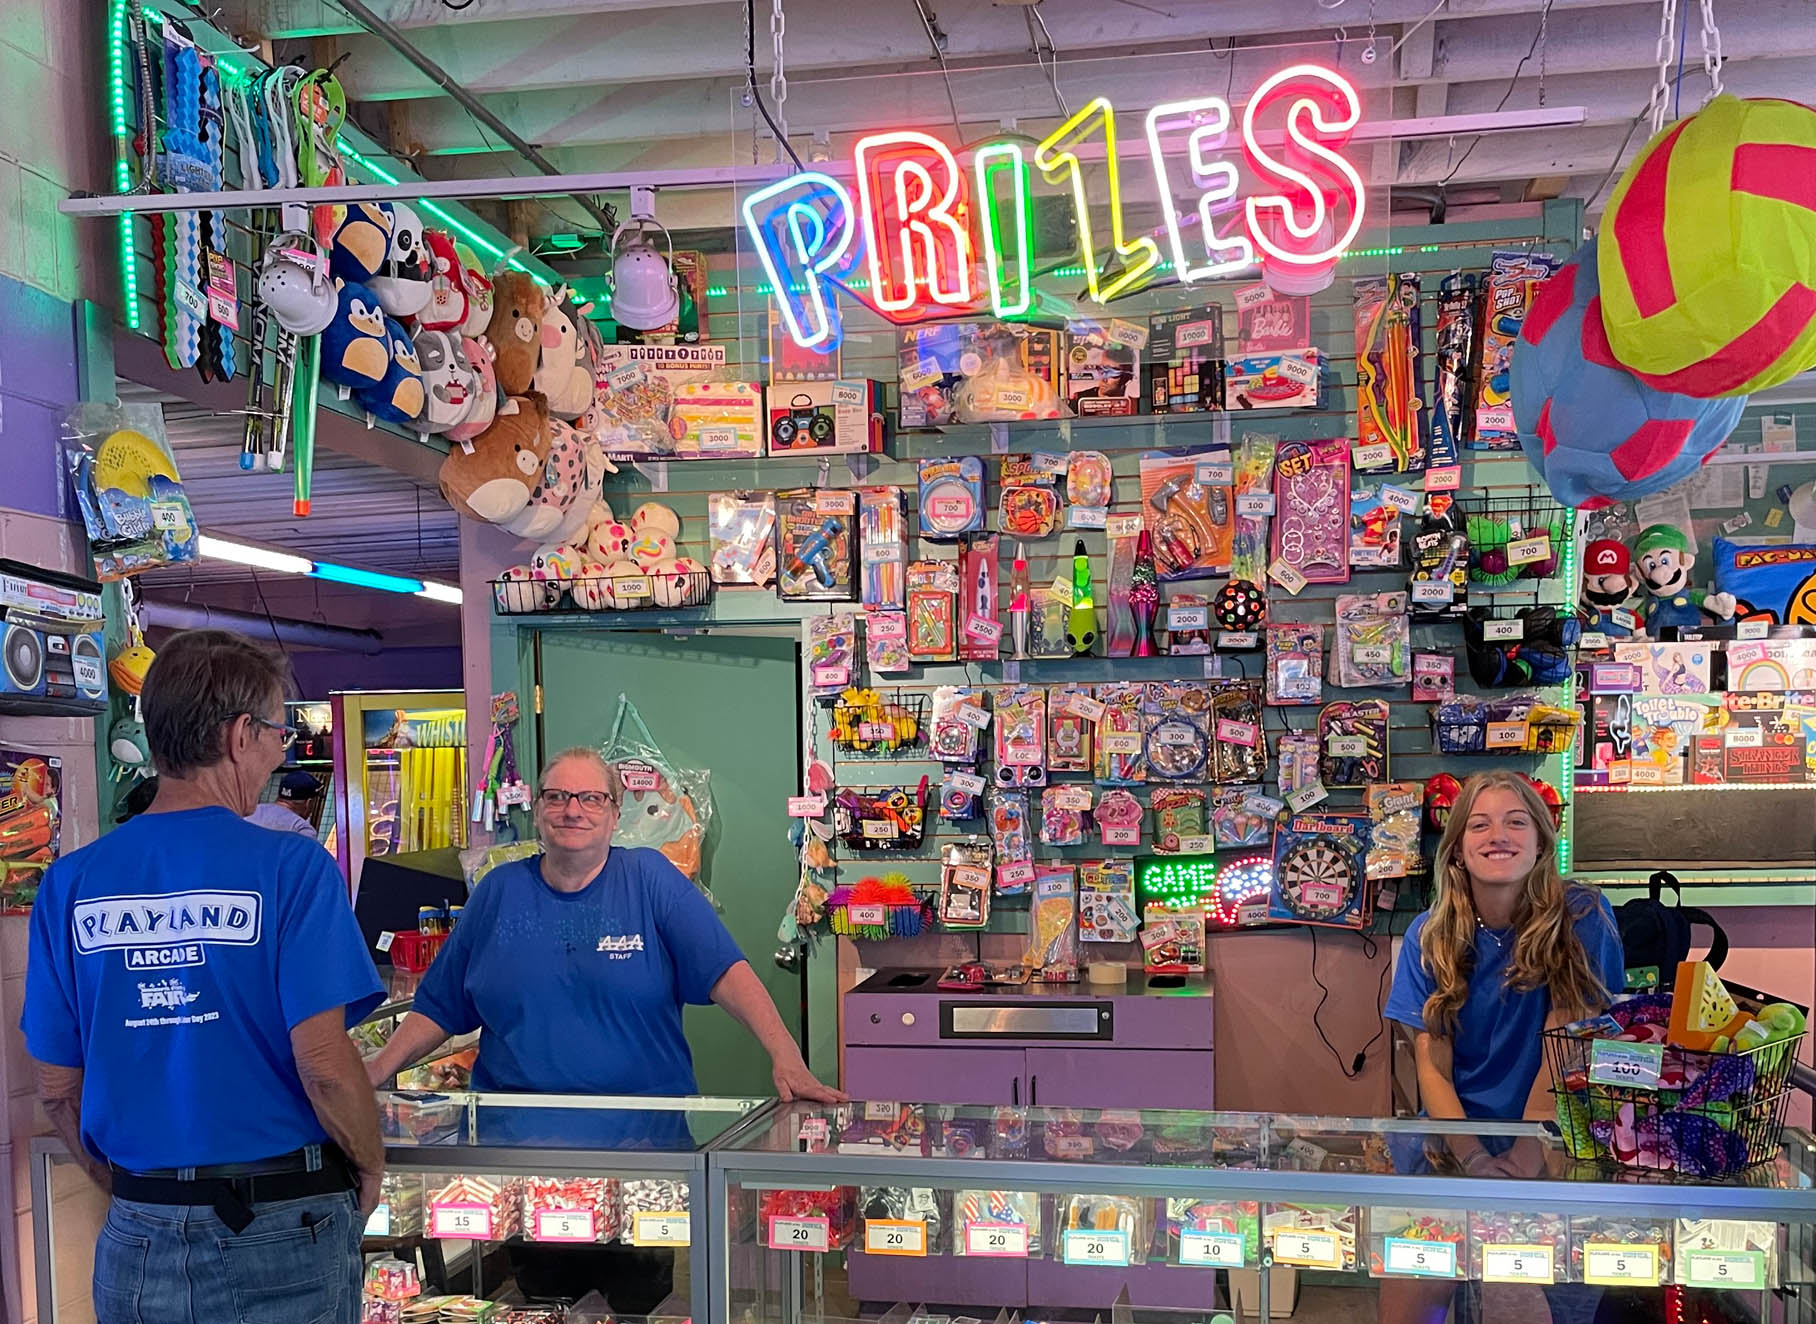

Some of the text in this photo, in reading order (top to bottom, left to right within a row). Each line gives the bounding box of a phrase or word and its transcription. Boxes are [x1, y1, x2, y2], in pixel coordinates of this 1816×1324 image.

[1243, 291, 1265, 304] 5000
[1494, 287, 1514, 300] POP
[185, 291, 199, 310] 700
[1495, 293, 1522, 309] SHOT
[217, 303, 230, 317] 500
[1251, 316, 1292, 340] Barbie
[904, 326, 940, 344] NERF
[1286, 363, 1308, 377] 9000
[1485, 416, 1505, 425] 2000
[1362, 450, 1384, 461] 2000
[1044, 458, 1059, 467] 700
[1278, 452, 1313, 477] SET
[1207, 470, 1223, 479] 700
[1247, 501, 1264, 510] 100
[1388, 494, 1410, 506] 4000
[943, 504, 959, 512] 700
[161, 512, 176, 523] 400
[1520, 547, 1537, 556] 700
[1421, 588, 1444, 596] 2000
[1176, 615, 1198, 624] 2000
[880, 624, 895, 633] 250
[973, 623, 994, 635] 2500
[79, 666, 96, 680] 4000
[824, 672, 839, 680] 400
[1078, 703, 1094, 714] 200
[1632, 698, 1677, 715] Toilet
[966, 711, 981, 721] 400
[1644, 707, 1699, 725] Trouble
[1168, 733, 1185, 741] 300
[1229, 728, 1245, 738] 500
[1634, 770, 1656, 778] 4000
[959, 778, 975, 788] 300
[1299, 791, 1315, 802] 100
[1383, 792, 1416, 808] Giant
[1292, 818, 1354, 834] Dartboard
[1113, 831, 1129, 839] 200
[1188, 841, 1204, 850] 250
[962, 873, 980, 883] 350
[1010, 869, 1025, 878] 250
[1144, 863, 1216, 893] GAME
[1314, 892, 1330, 900] 700
[859, 911, 875, 919] 400
[1114, 908, 1129, 922] 200
[80, 904, 251, 941] PLAYLAND
[1150, 930, 1166, 941] 300
[131, 946, 199, 966] ARCADE
[609, 952, 633, 960] STAFF
[1611, 1060, 1641, 1076] 100
[454, 1216, 470, 1227] 15
[561, 1221, 570, 1232] 5
[660, 1225, 669, 1236] 5
[792, 1229, 809, 1240] 20
[887, 1233, 903, 1244] 20
[989, 1234, 1006, 1246] 20
[1087, 1243, 1104, 1254] 20
[1203, 1244, 1221, 1256] 10
[1301, 1242, 1310, 1253] 5
[1416, 1252, 1426, 1264] 5
[1513, 1259, 1523, 1271] 5
[1616, 1259, 1626, 1271] 5
[1717, 1264, 1728, 1276] 5
